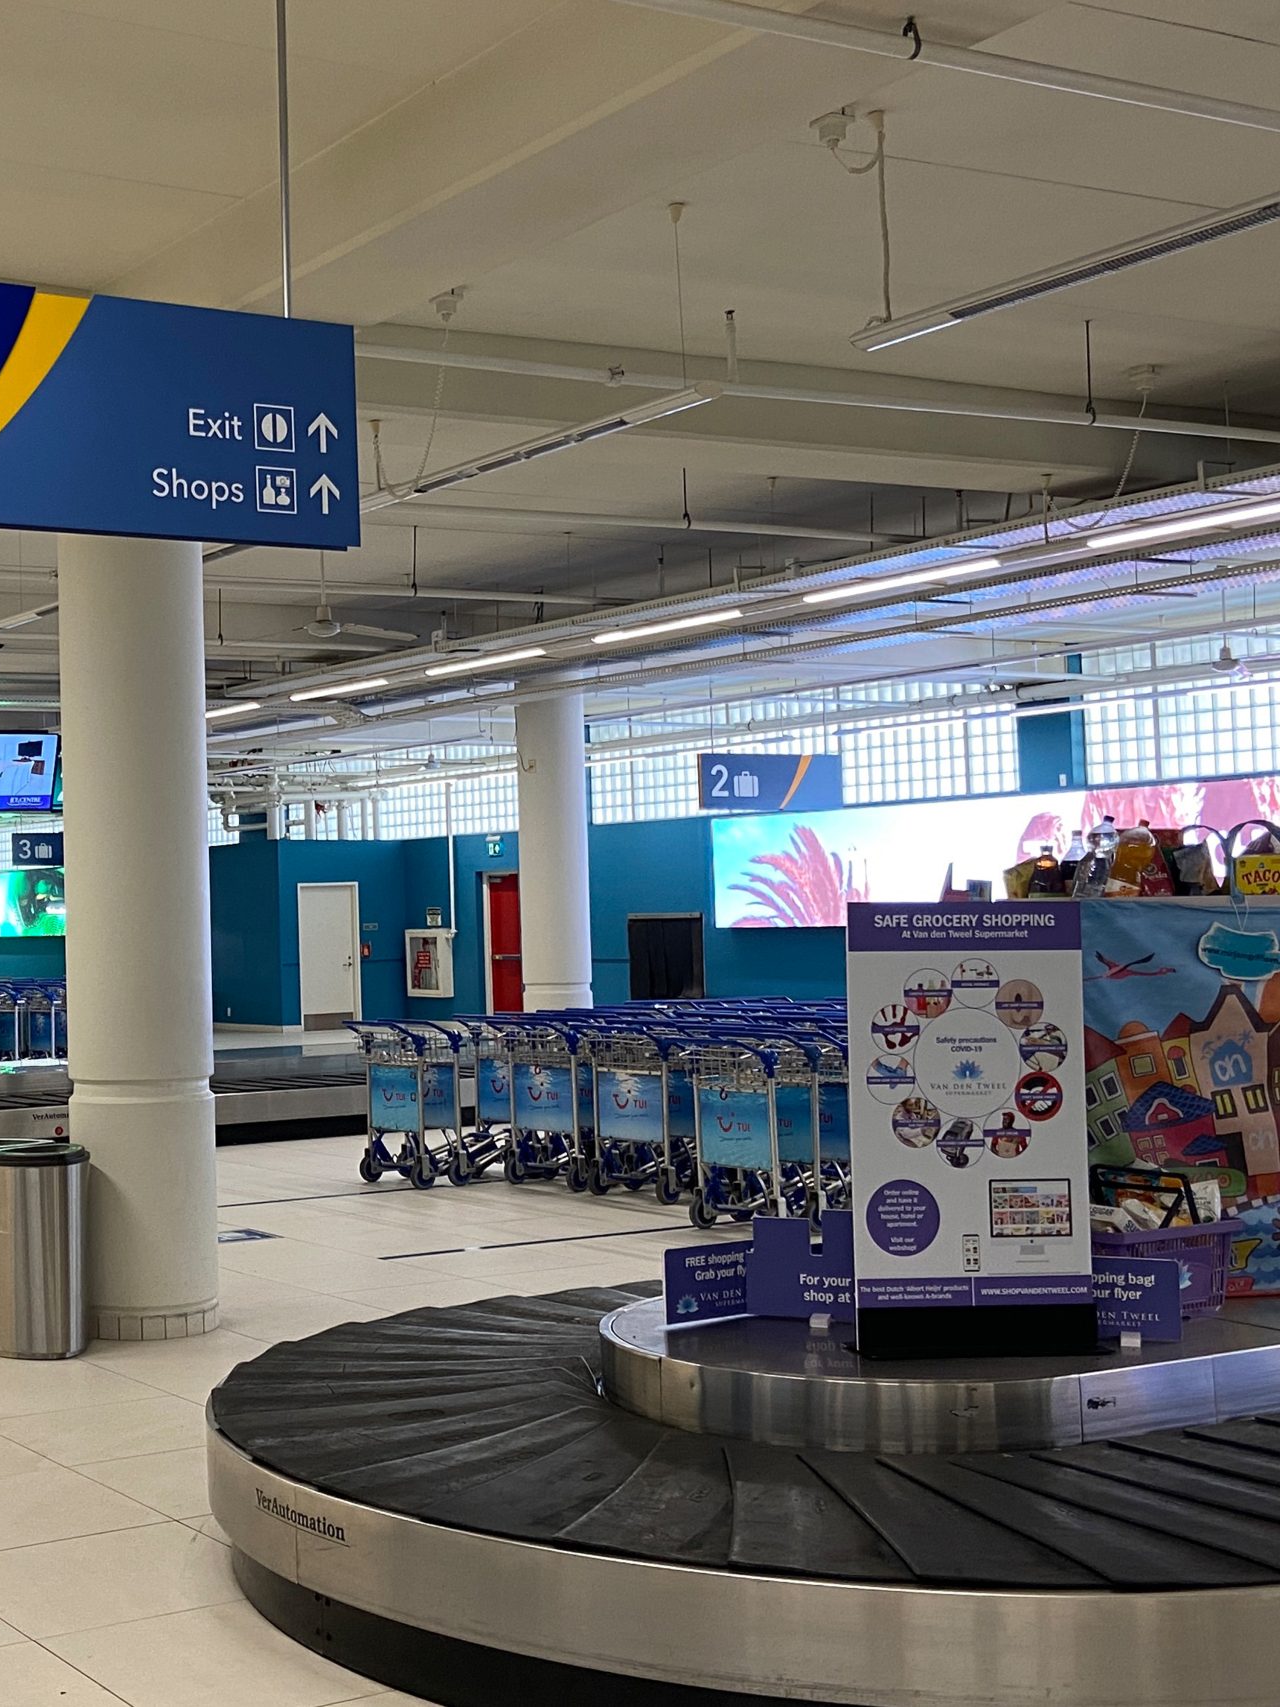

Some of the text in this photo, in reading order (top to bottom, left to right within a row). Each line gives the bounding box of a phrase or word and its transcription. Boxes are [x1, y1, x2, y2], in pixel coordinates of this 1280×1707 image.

[188, 409, 243, 440] Exit
[152, 467, 244, 509] Shops
[710, 764, 729, 797] 2
[19, 840, 31, 859] 3
[874, 914, 1055, 927] SAFE GROCERY SHOPPING
[901, 930, 1028, 939] At Van den Tweel Supermarket
[930, 1082, 949, 1090] VAN
[546, 1091, 559, 1100] TUI
[633, 1099, 648, 1109] TUI
[736, 1122, 751, 1132] TUI
[685, 1251, 745, 1268] FREE shopping
[695, 1264, 746, 1281] Grab your fly
[799, 1274, 852, 1288] For your
[1091, 1272, 1155, 1288] pping bag!
[700, 1288, 742, 1301] VAN DEN
[803, 1290, 851, 1304] shop at
[980, 1286, 1088, 1295] WWW.SHOPVANDENTWEEL.COM
[1092, 1288, 1142, 1301] our flyer
[715, 1299, 745, 1307] SUPERMA
[1121, 1310, 1161, 1322] TWEEL
[255, 1487, 346, 1542] VerAutomation
